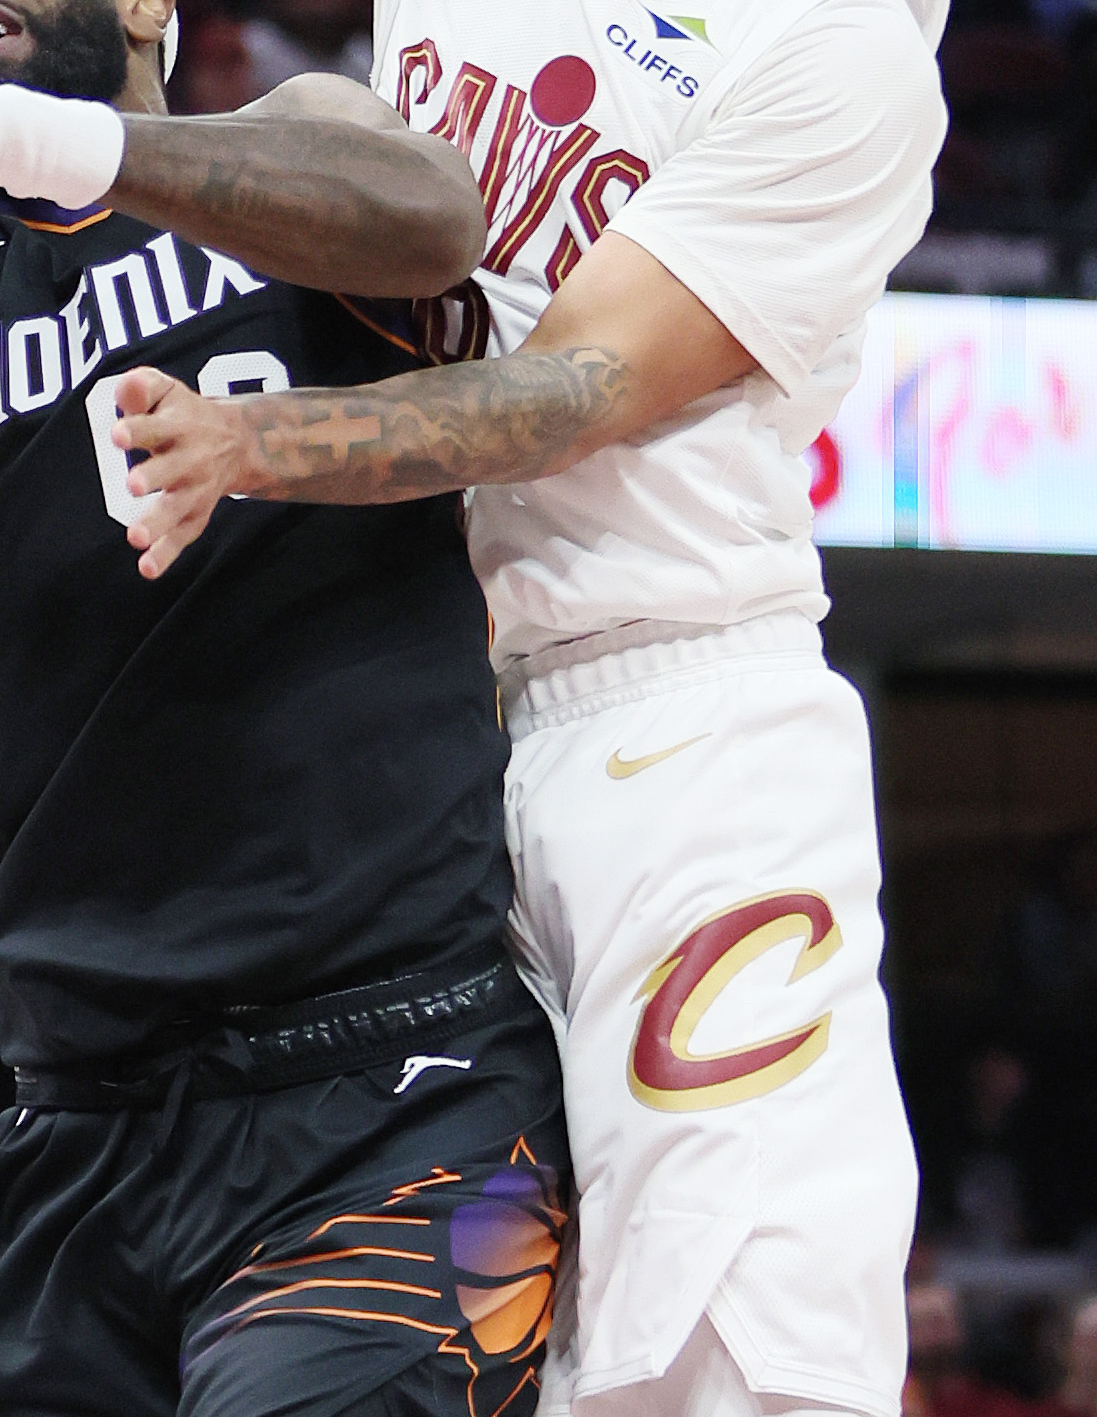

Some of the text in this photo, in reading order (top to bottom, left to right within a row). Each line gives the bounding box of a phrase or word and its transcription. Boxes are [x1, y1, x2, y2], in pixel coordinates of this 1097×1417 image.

[396, 38, 650, 294] CAVS
[605, 23, 700, 99] CLIFFS
[626, 887, 843, 1113] C
